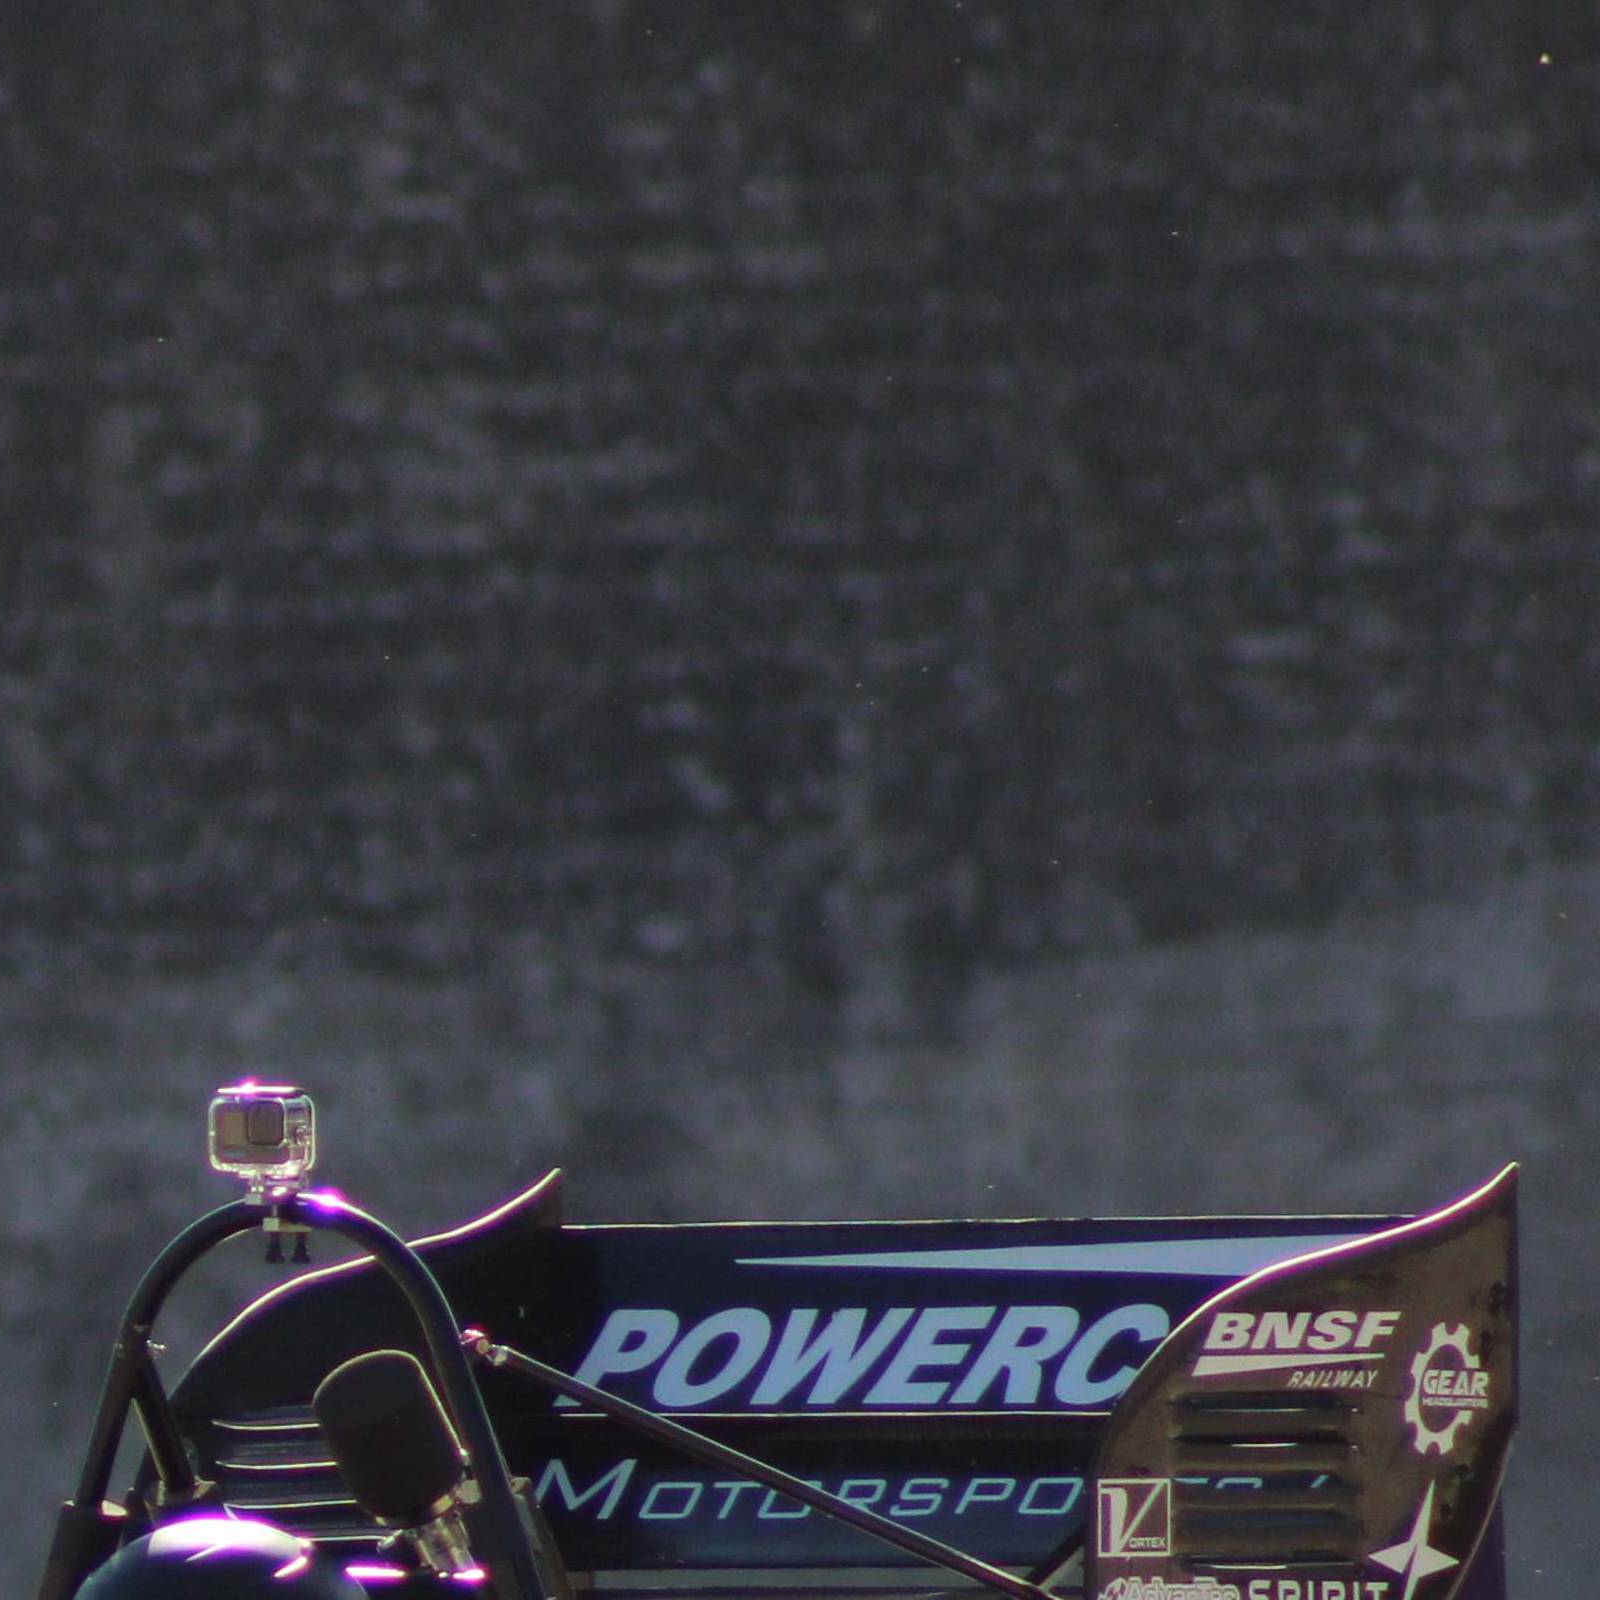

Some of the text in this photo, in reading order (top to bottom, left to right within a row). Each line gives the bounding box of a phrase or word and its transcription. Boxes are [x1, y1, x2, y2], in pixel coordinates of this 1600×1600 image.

[1203, 1311, 1401, 1350] BNSF
[1287, 1370, 1378, 1389] RAILWAY
[1422, 1370, 1489, 1397] GEAR
[536, 1458, 1262, 1520] MOTORSPO
